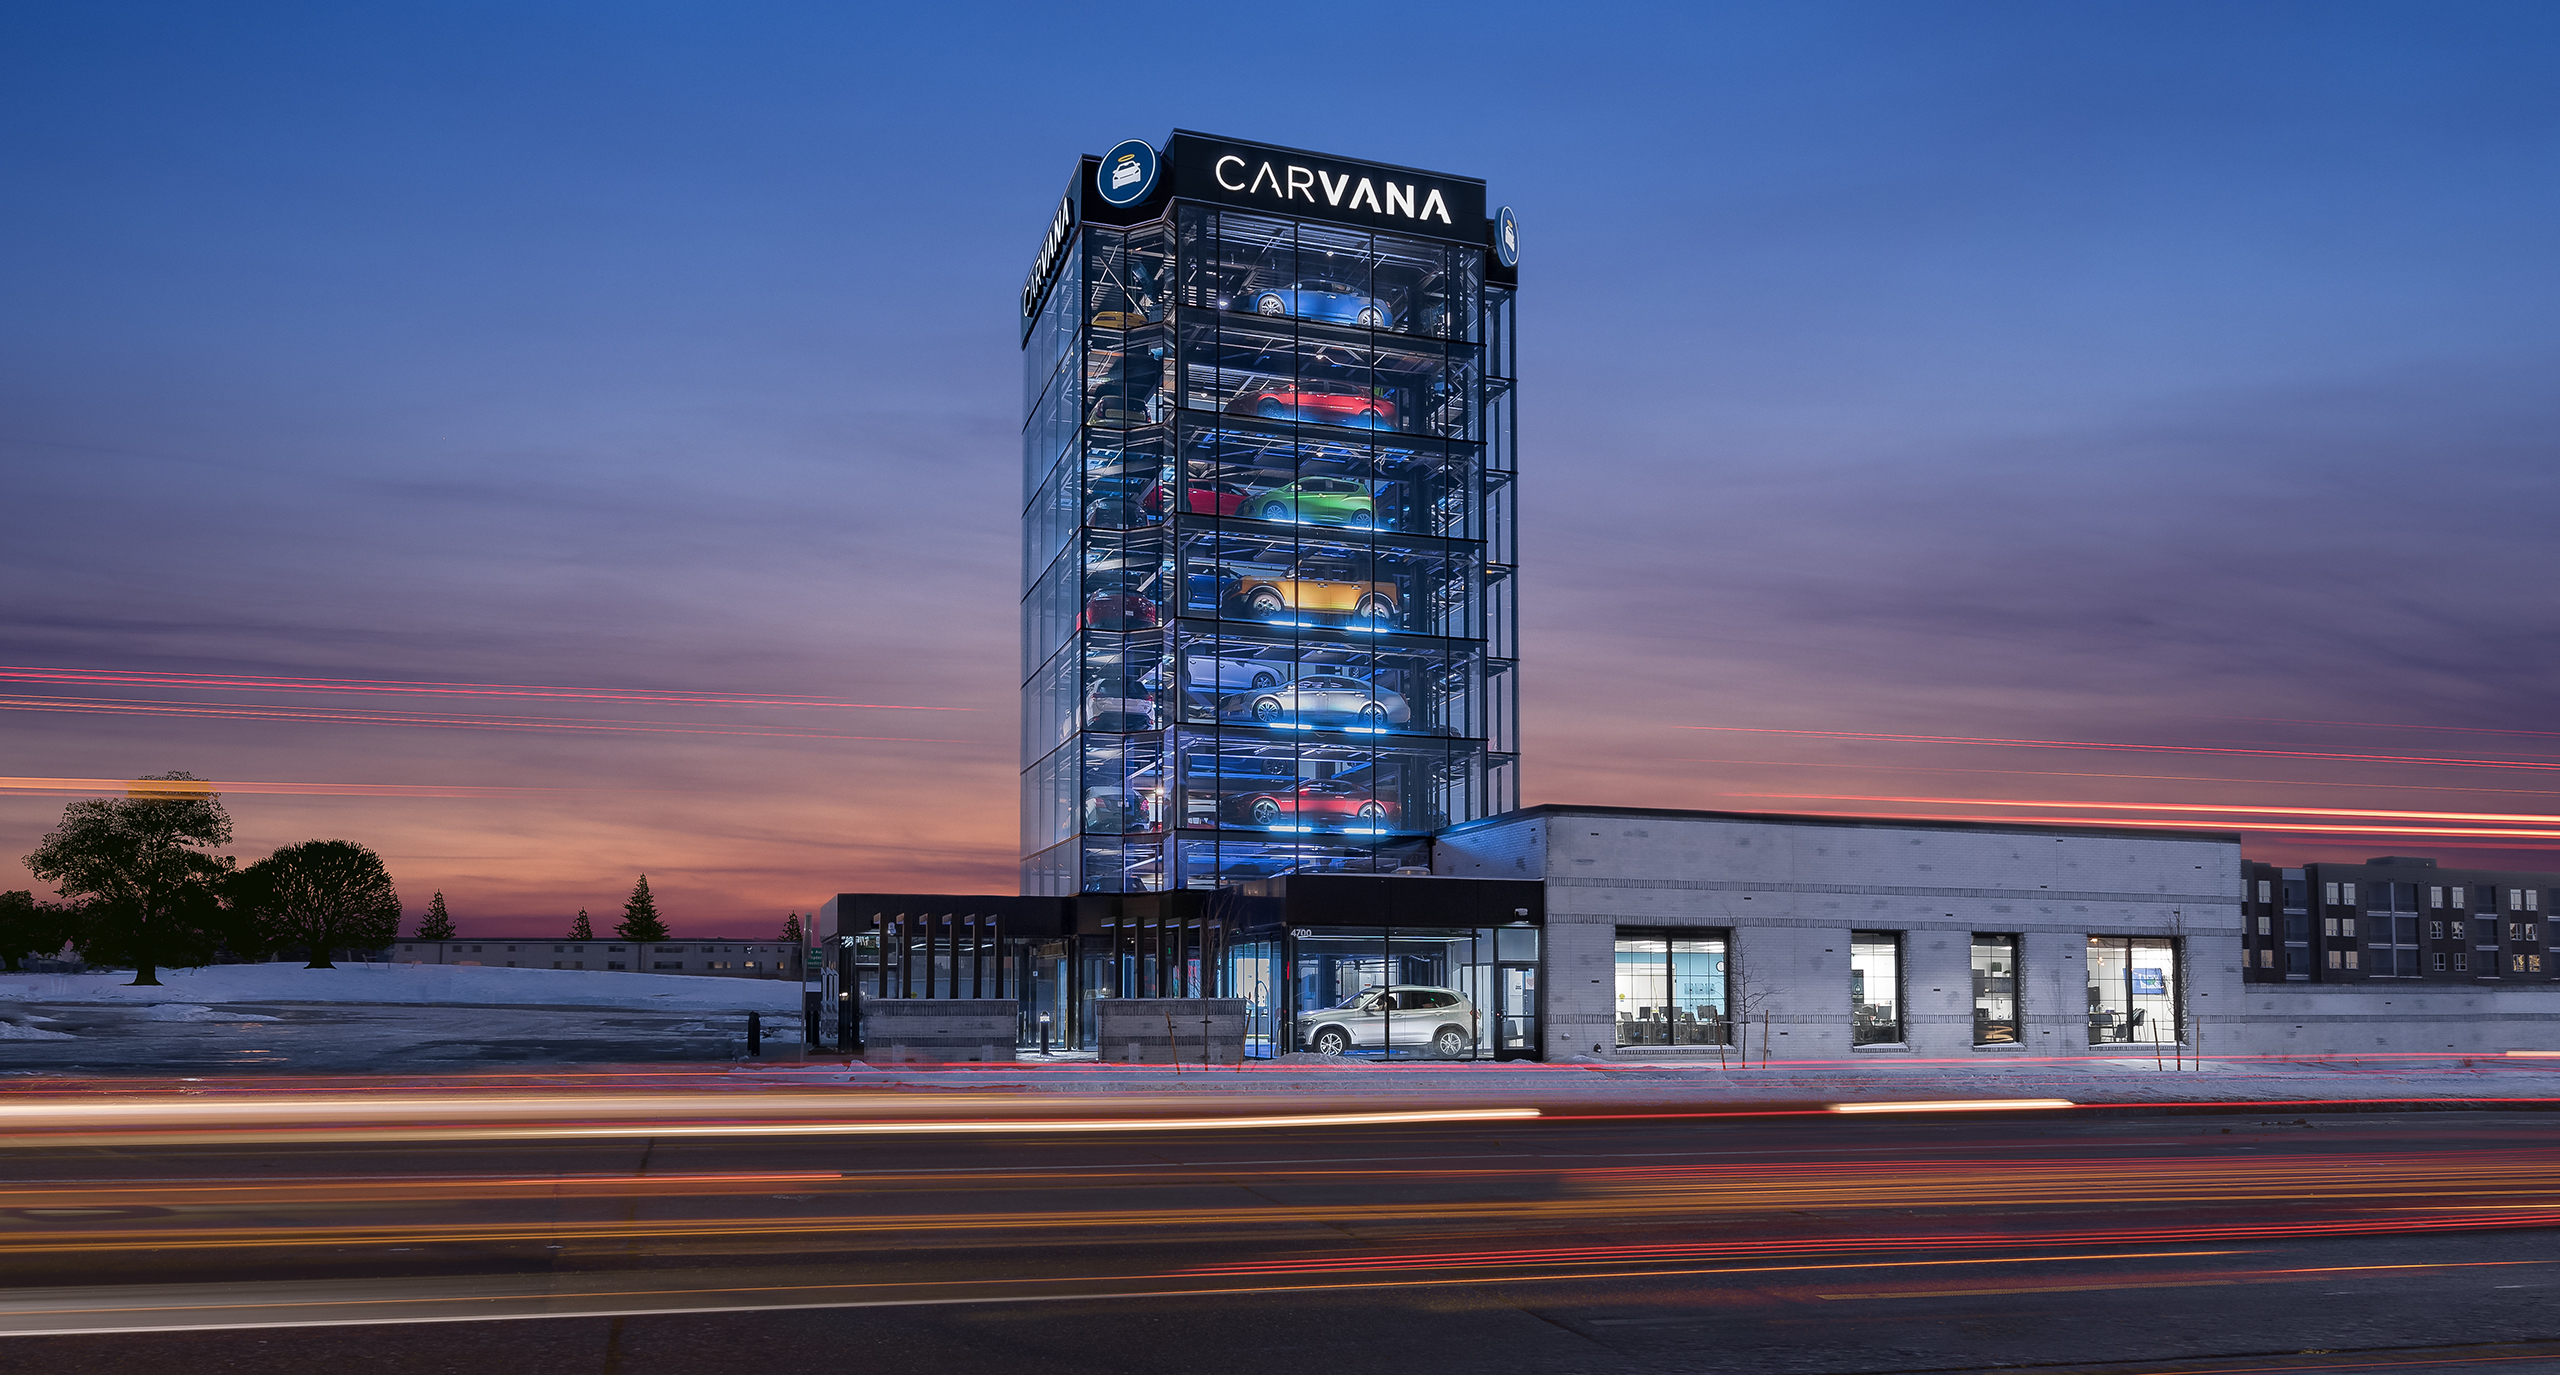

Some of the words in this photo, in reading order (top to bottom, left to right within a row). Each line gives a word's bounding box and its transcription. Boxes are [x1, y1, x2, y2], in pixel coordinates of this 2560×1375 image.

[1215, 155, 1452, 224] CARVANA
[1023, 197, 1070, 317] CARVANA
[1290, 928, 1312, 937] 4700
